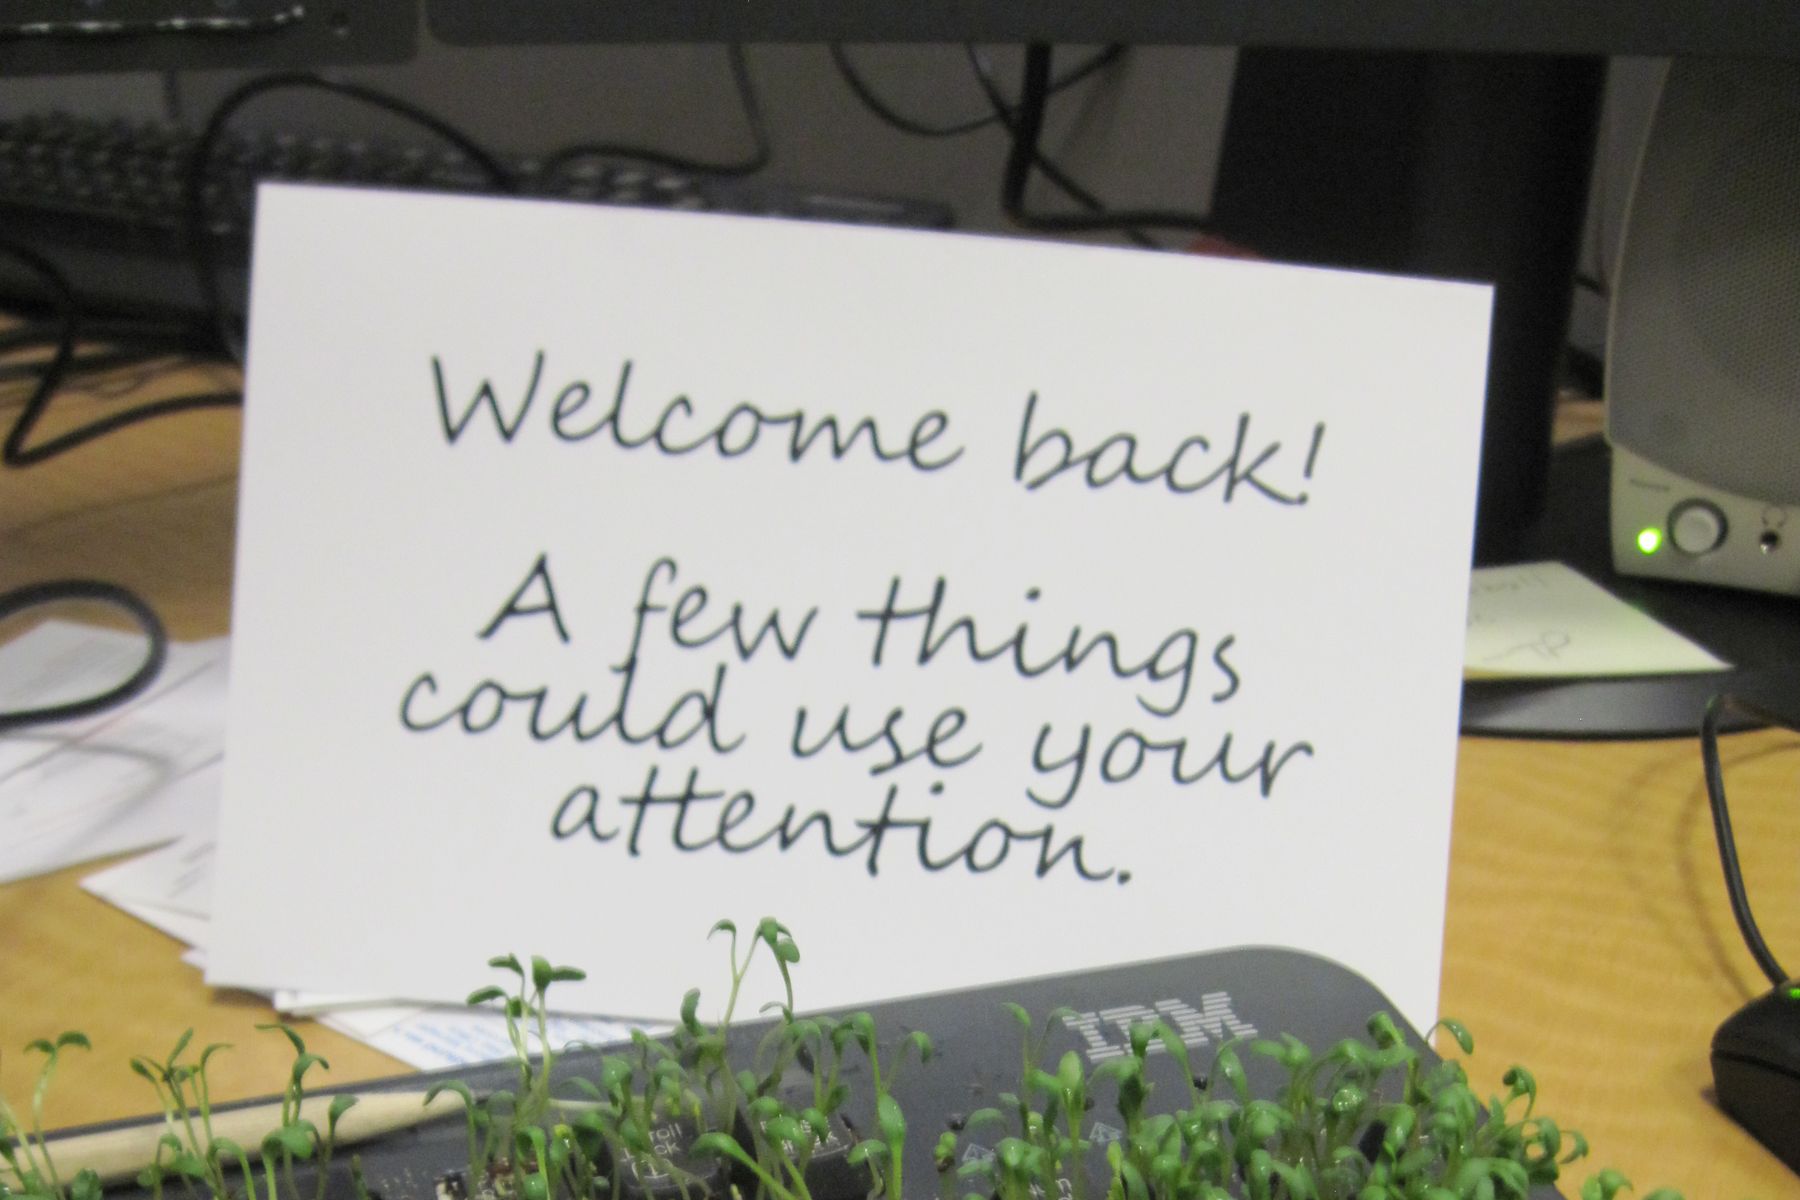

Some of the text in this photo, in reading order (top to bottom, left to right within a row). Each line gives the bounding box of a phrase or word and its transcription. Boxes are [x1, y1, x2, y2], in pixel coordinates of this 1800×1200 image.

[431, 350, 1325, 506] Welcome back!
[478, 553, 1241, 718] A few things
[399, 660, 1314, 810] could use your
[550, 765, 1132, 884] attention.
